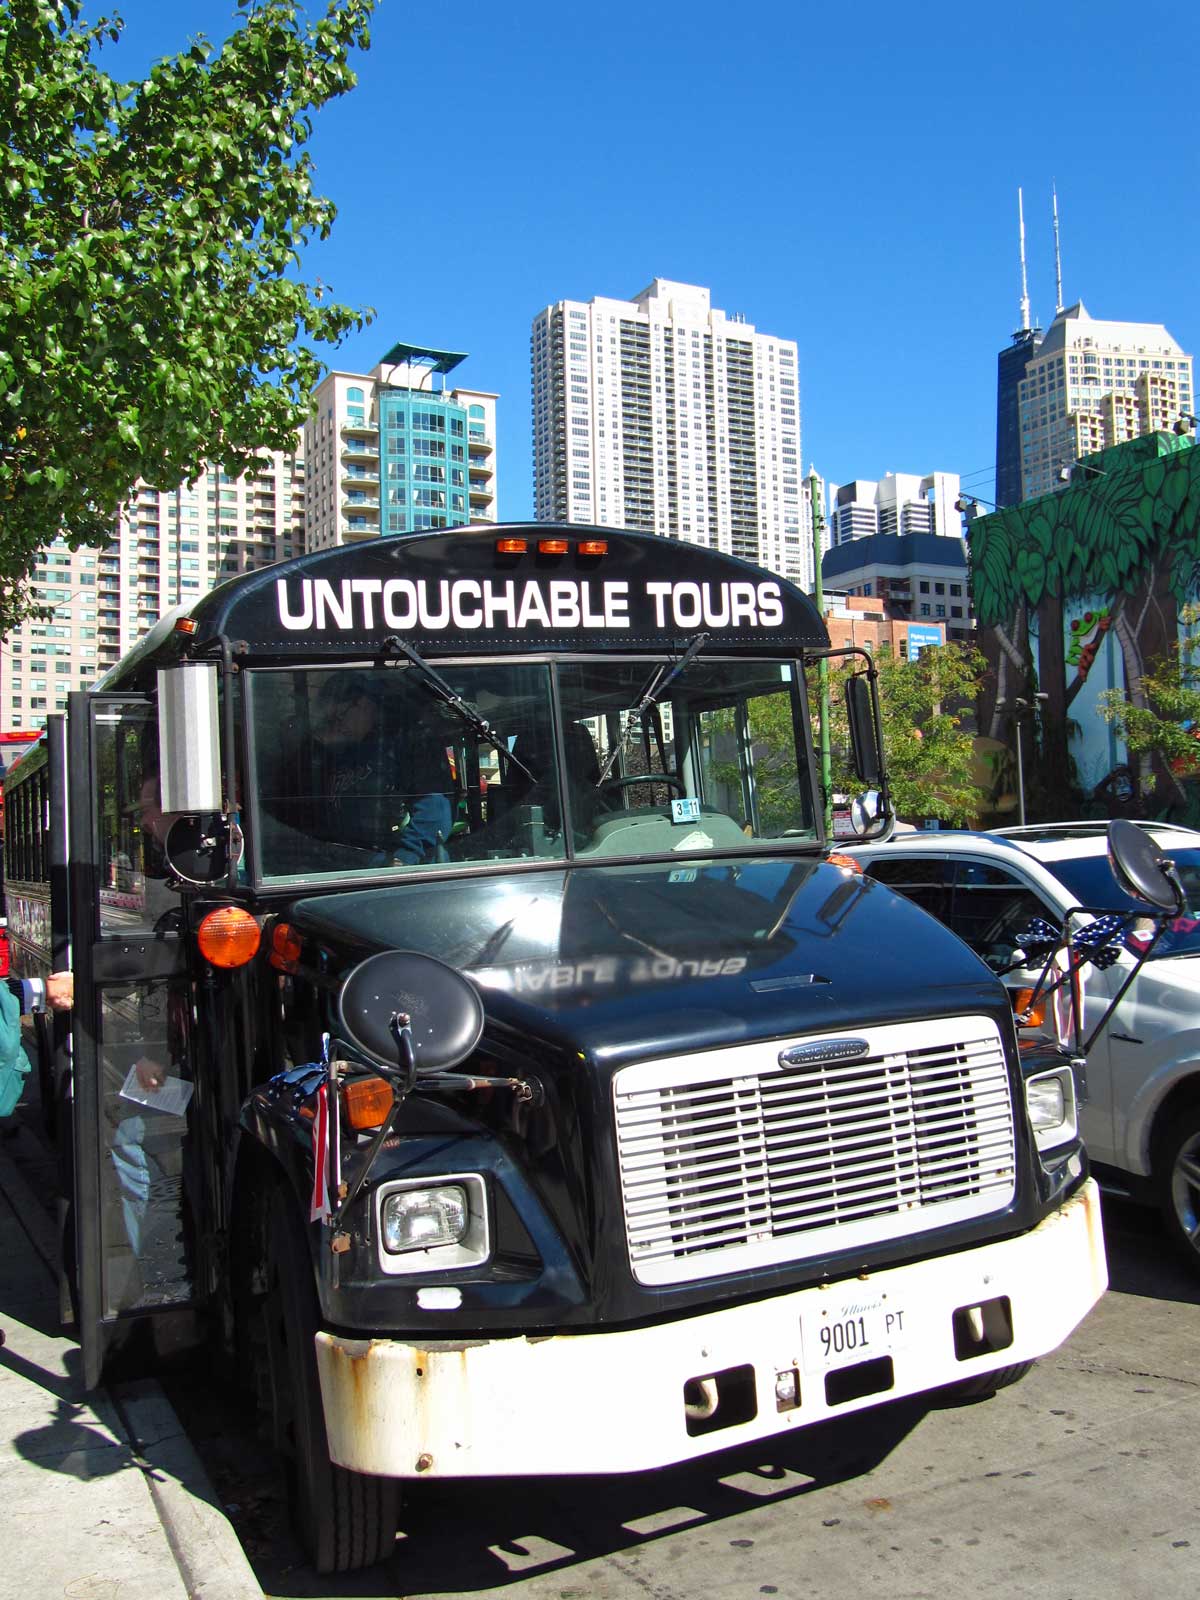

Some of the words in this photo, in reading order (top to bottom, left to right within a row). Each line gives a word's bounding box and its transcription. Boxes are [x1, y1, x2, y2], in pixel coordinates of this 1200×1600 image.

[276, 578, 631, 630] UNTOUCHABLE
[647, 580, 784, 628] TOURS
[676, 803, 682, 816] 3
[689, 801, 699, 815] 11
[820, 1317, 869, 1356] 9001
[885, 1311, 904, 1334] PT
